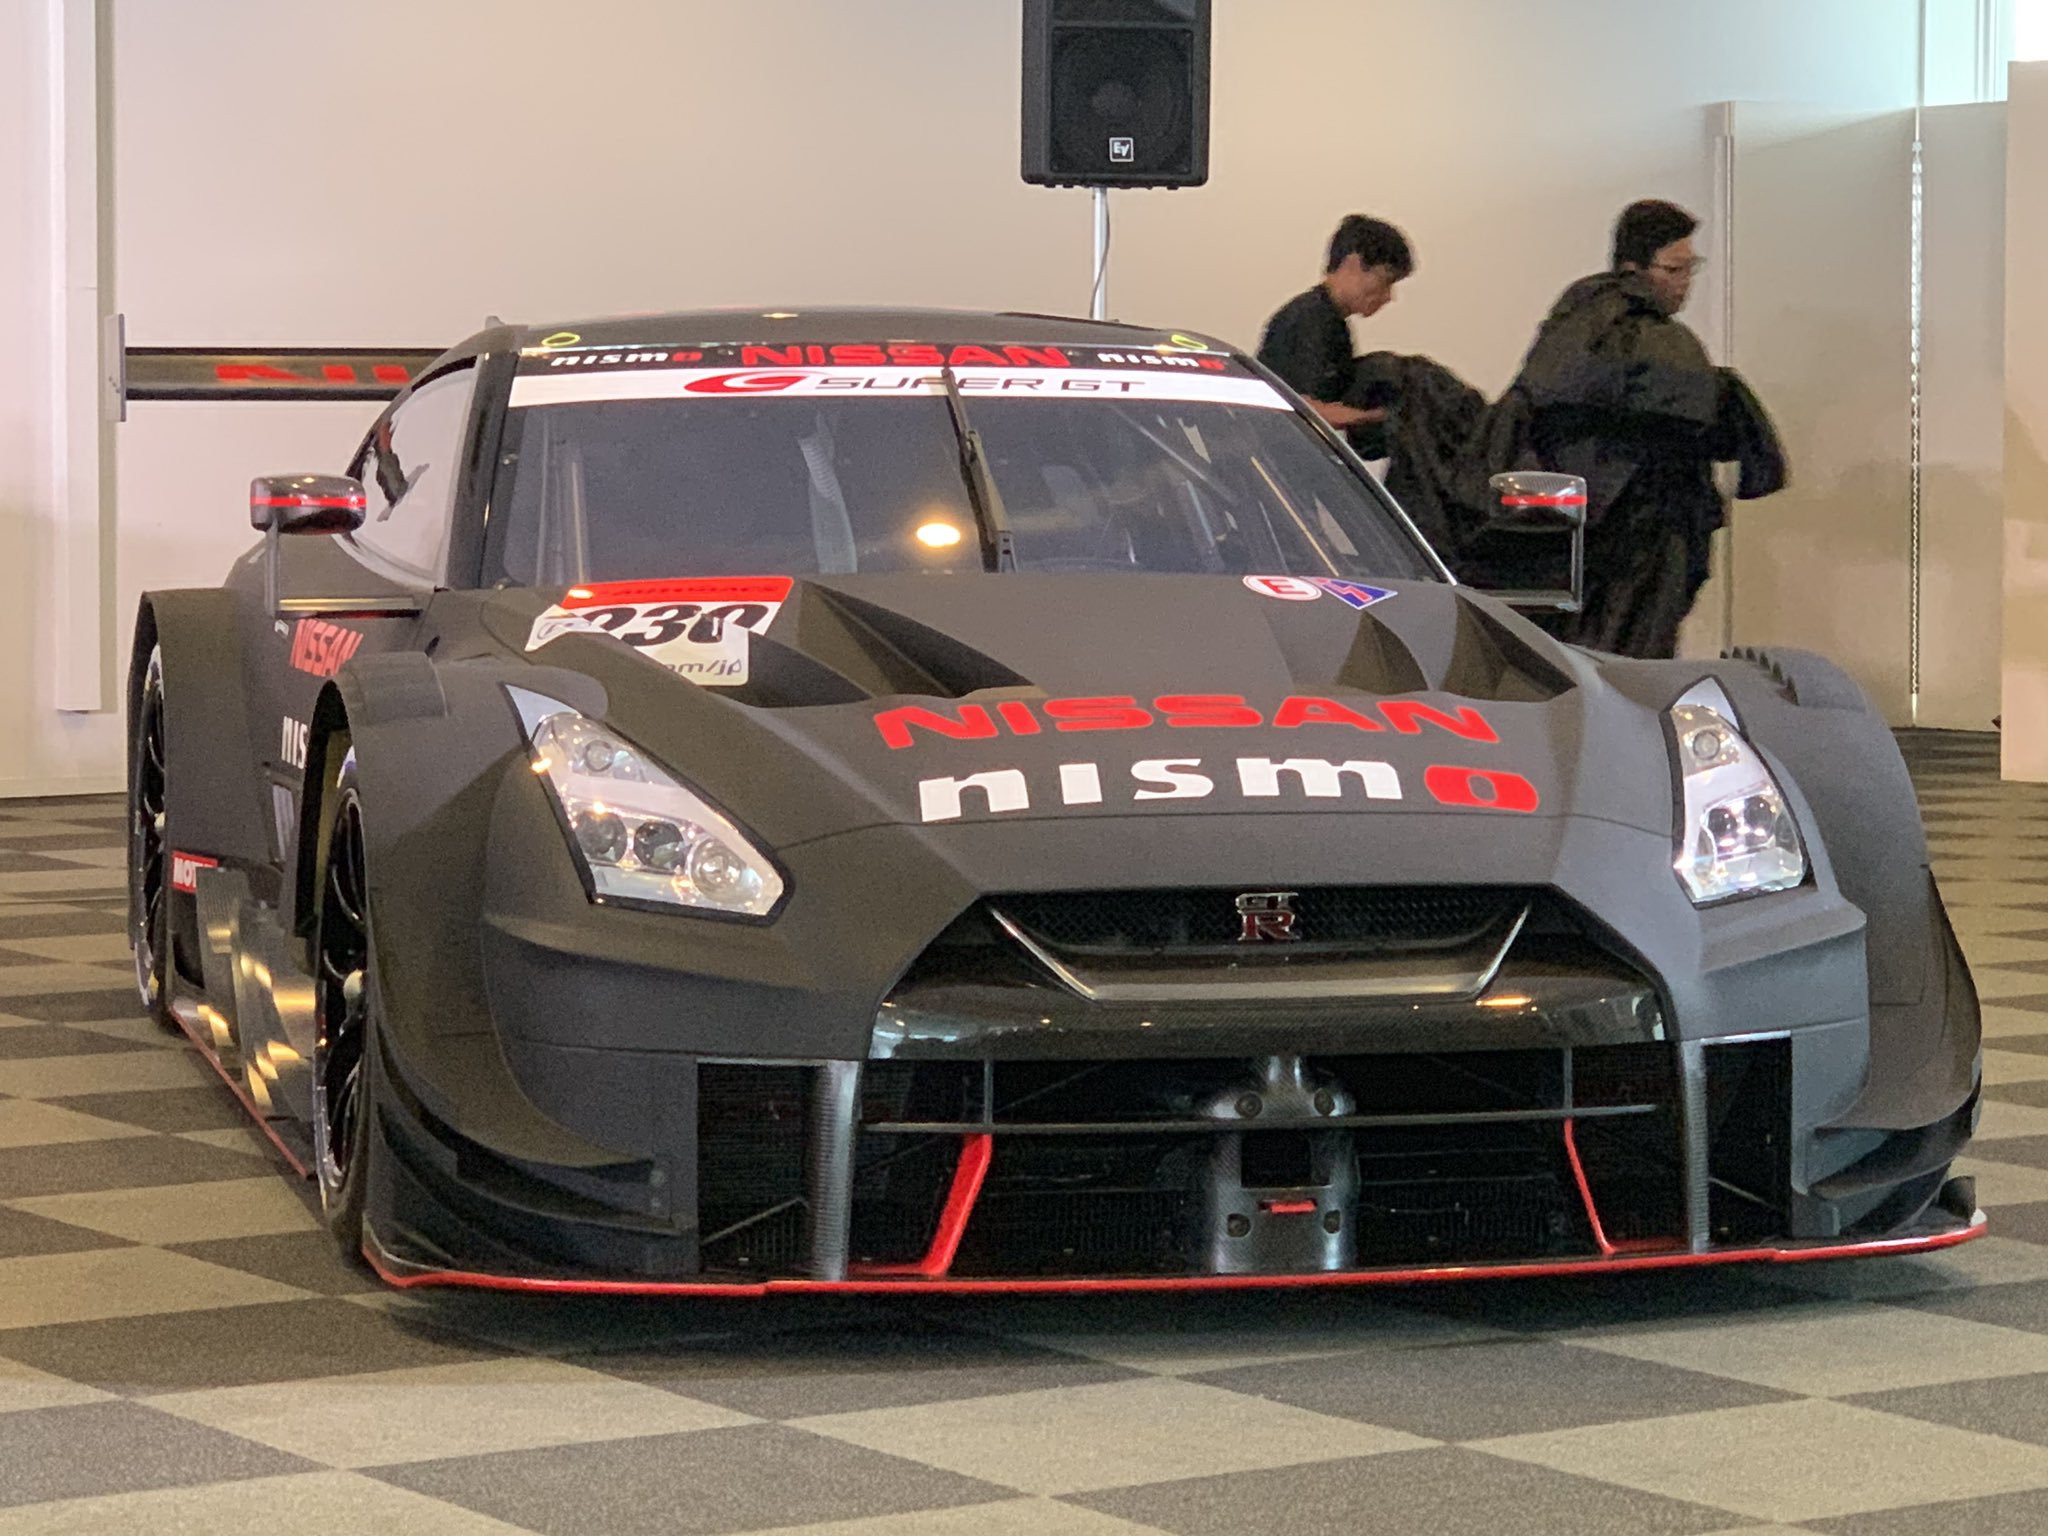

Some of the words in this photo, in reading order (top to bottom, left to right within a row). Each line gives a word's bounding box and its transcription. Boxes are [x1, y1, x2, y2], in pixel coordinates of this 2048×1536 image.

[551, 351, 704, 368] nismo
[741, 344, 1071, 367] NISSAN
[1097, 352, 1226, 371] nismo
[815, 376, 1044, 391] SUPER
[1061, 378, 1146, 393] GT
[290, 618, 364, 677] NISSAN
[873, 694, 1501, 749] NISSAN
[918, 757, 1539, 822] nismo
